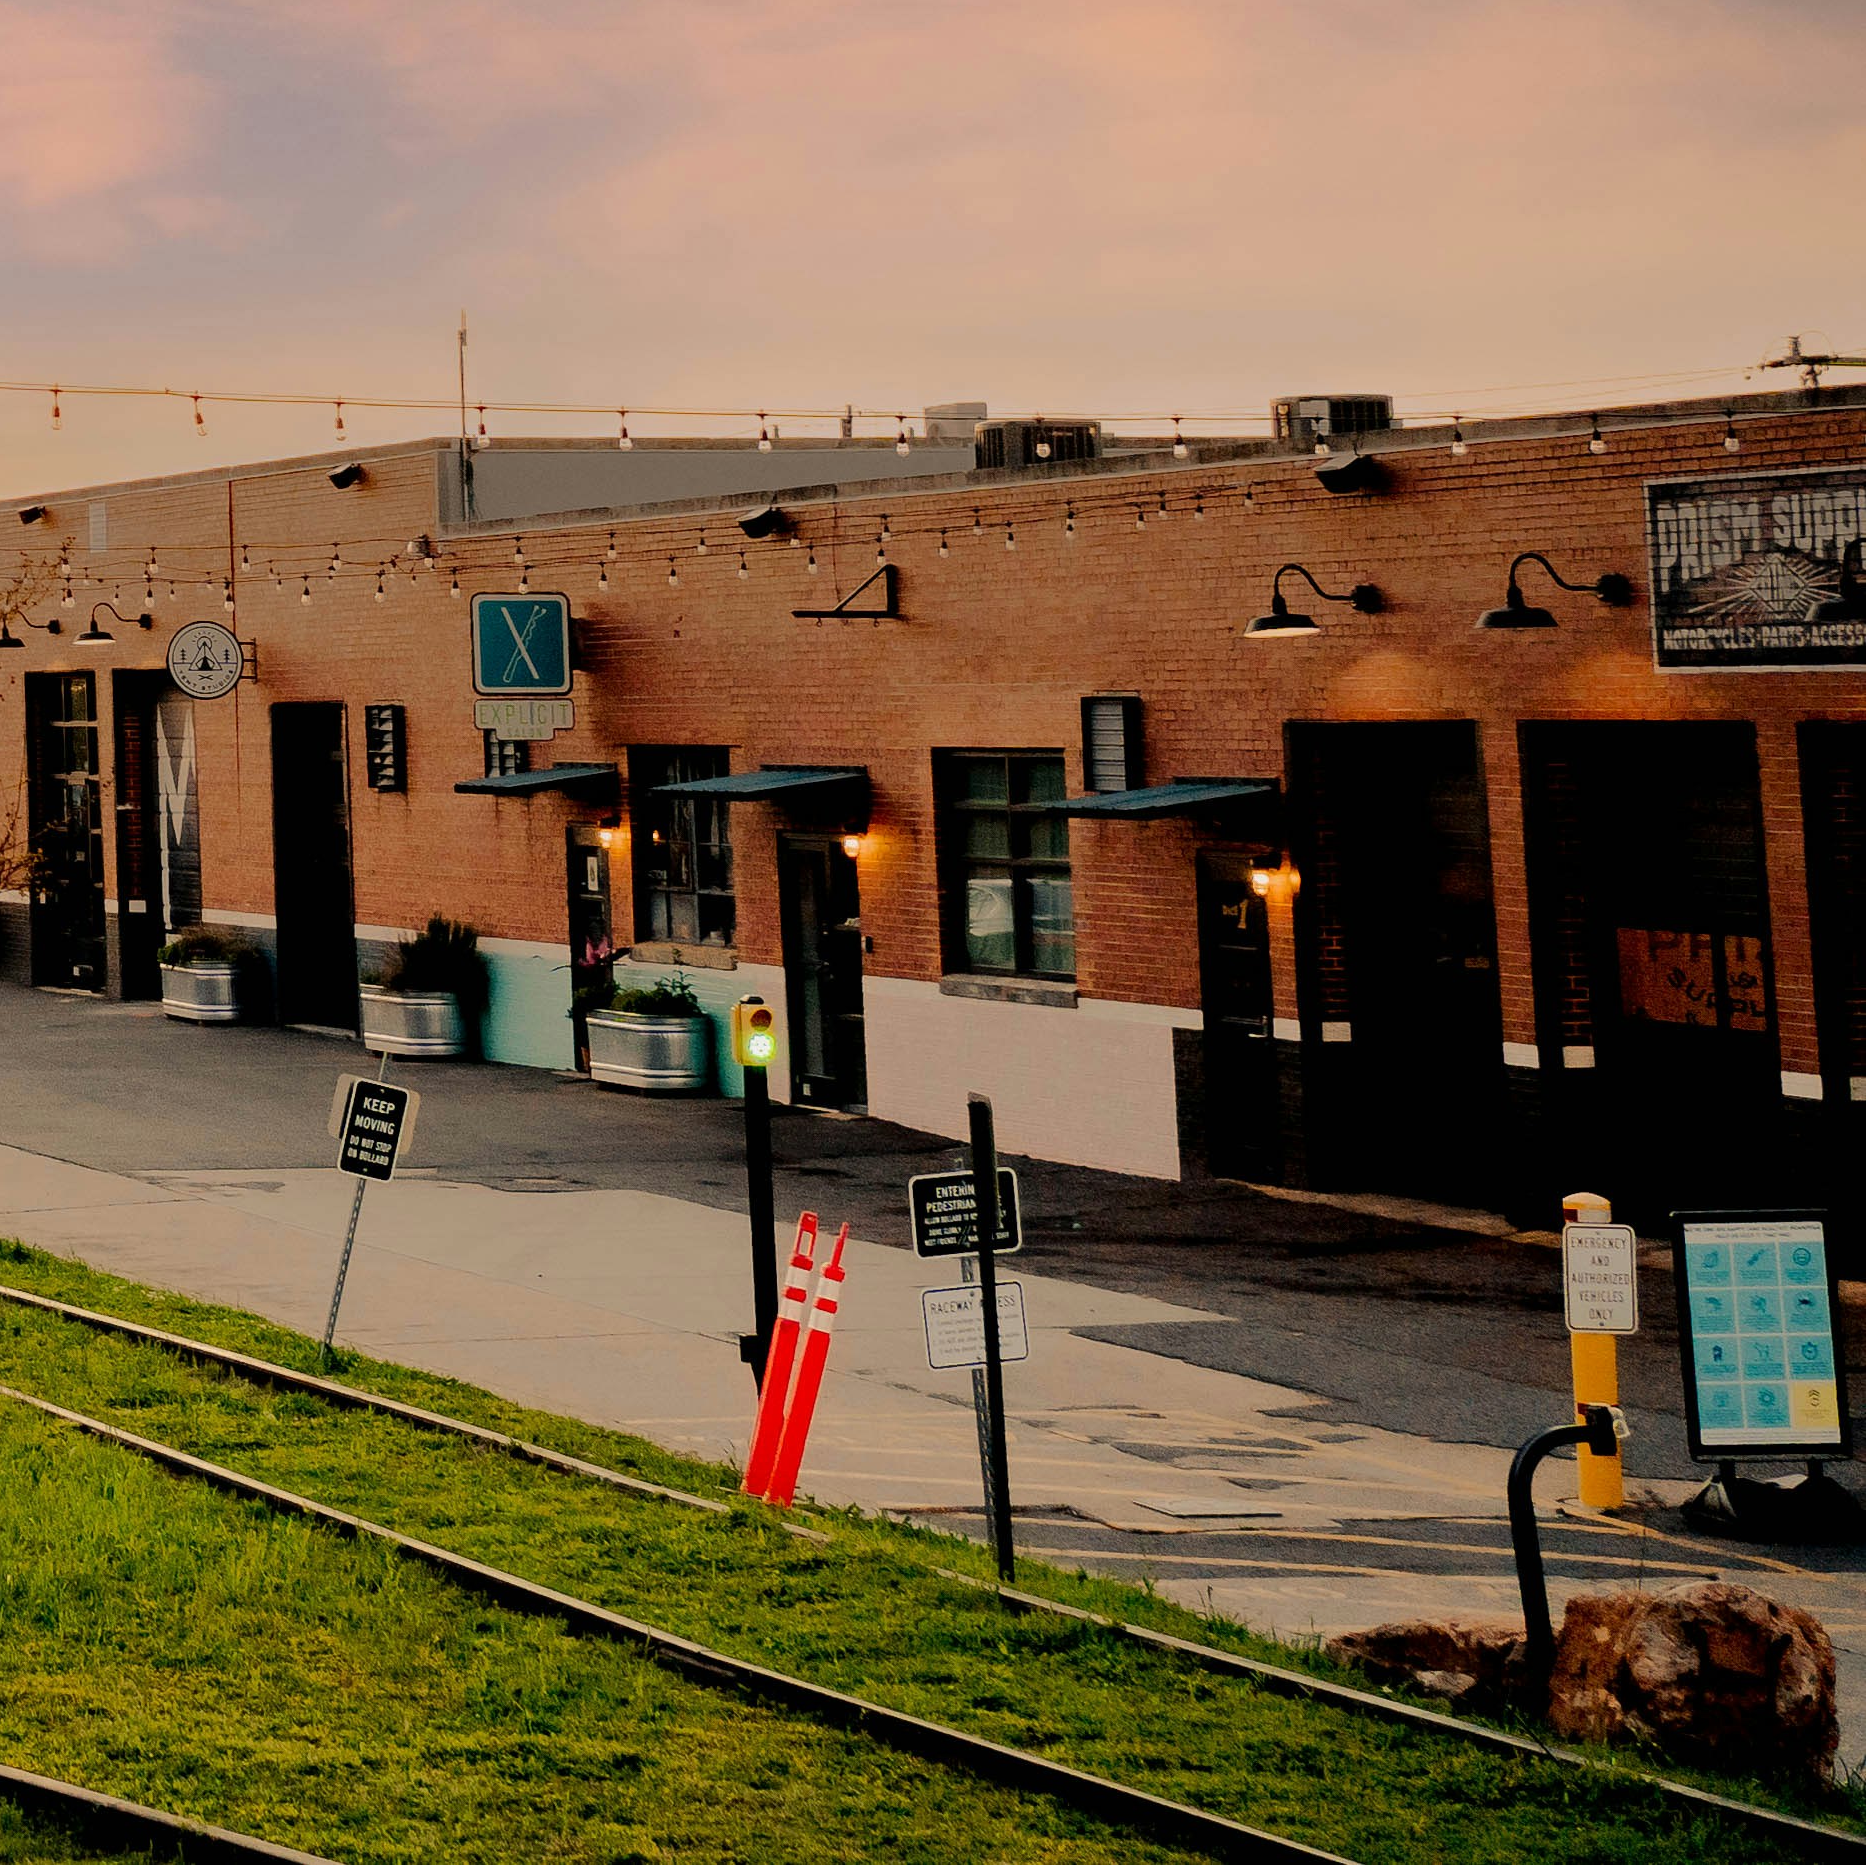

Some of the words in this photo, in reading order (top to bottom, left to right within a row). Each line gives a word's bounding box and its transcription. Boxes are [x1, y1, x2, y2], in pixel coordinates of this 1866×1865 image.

[1657, 497, 1760, 593] PRISM
[1664, 627, 1755, 650] MOTORCYCLES
[1762, 625, 1805, 648] PARTS
[479, 702, 568, 725] EXPLICIT
[363, 1097, 395, 1114] KEEP
[355, 1114, 395, 1134] MOVING
[349, 1134, 359, 1145] DO
[361, 1138, 374, 1148] NOT
[375, 1141, 392, 1152] STOP
[359, 1150, 389, 1165] BOLLARD
[936, 1184, 975, 1198] ENTERIN
[1571, 1237, 1626, 1249] EMERGENCY
[1591, 1256, 1610, 1266] AND
[1572, 1273, 1630, 1285] AUTHORIZED
[1579, 1291, 1624, 1302] VEHICLES
[930, 1301, 973, 1315] RACEWAY
[1589, 1309, 1613, 1320] ONLY
